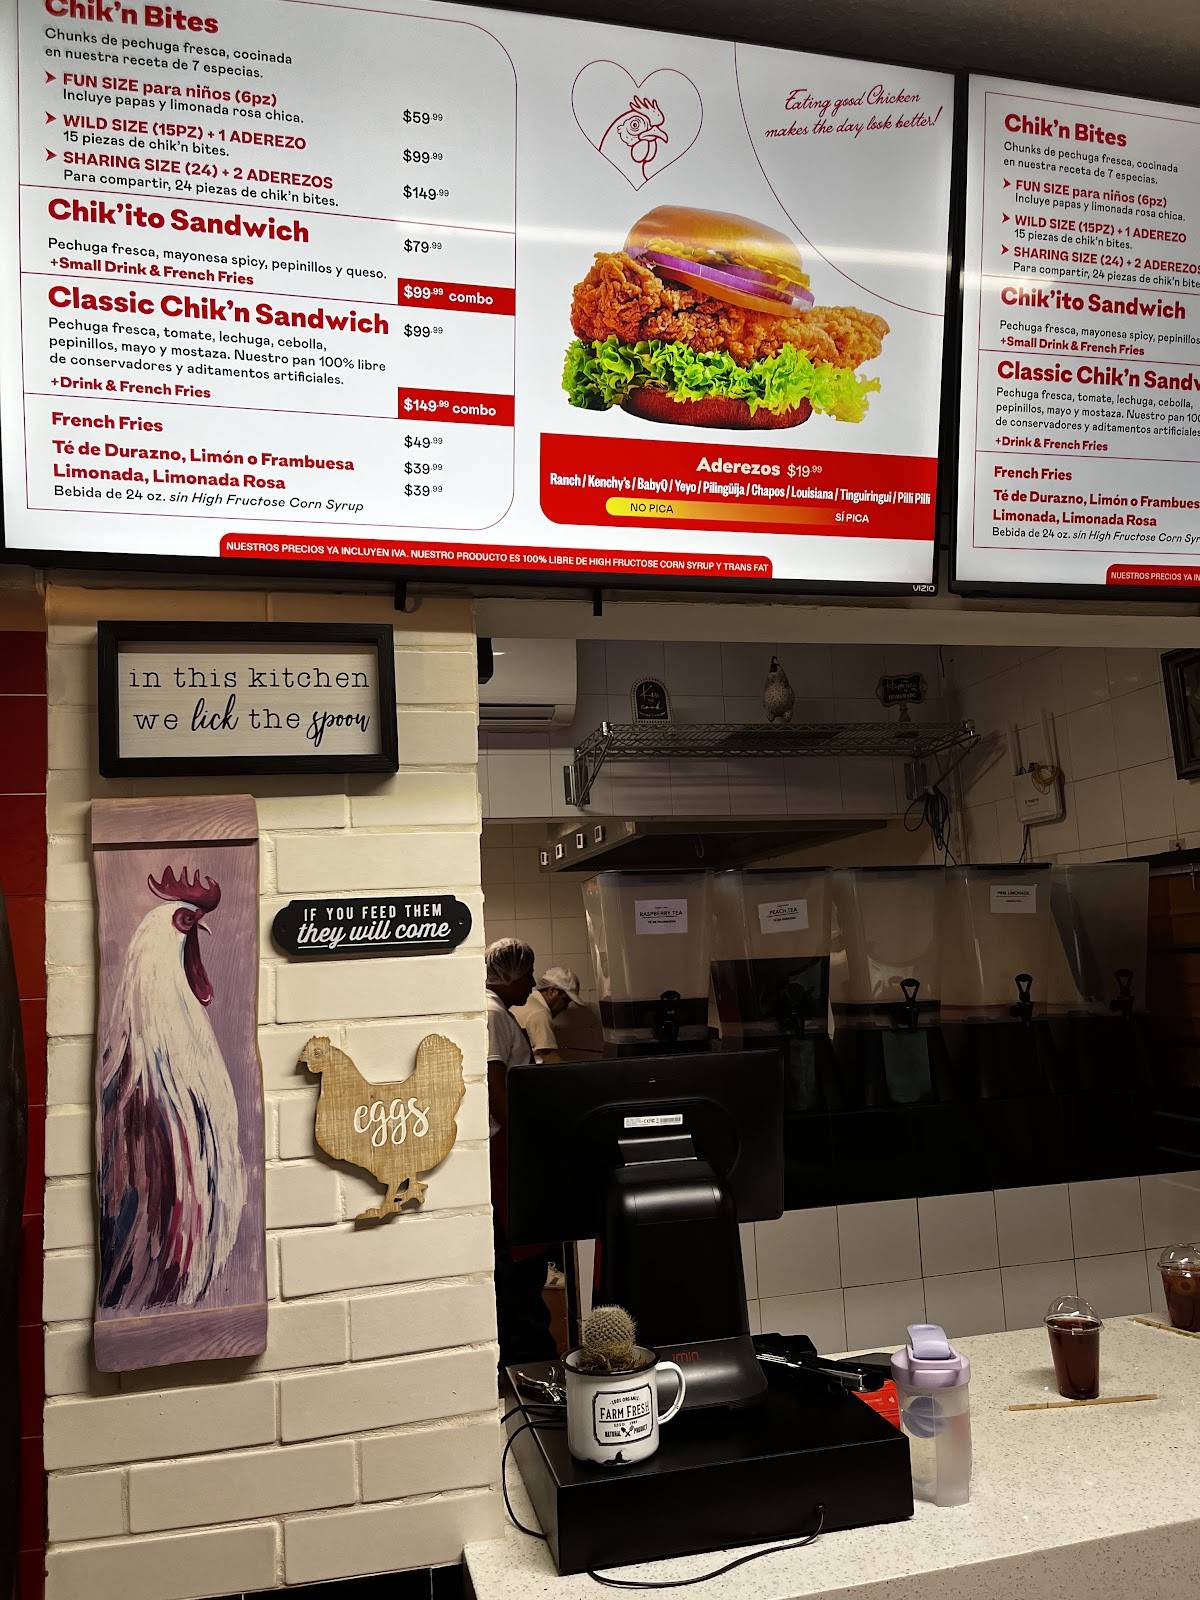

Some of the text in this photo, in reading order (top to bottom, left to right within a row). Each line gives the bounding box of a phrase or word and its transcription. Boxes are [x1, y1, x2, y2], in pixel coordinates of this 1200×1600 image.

[145, 5, 218, 33] Bites
[45, 27, 292, 64] Chunks de pechuga fresca, cocinada
[785, 84, 920, 118] Eating good Chicken
[402, 109, 443, 125] $59.99
[764, 105, 943, 139] makes the day look better!
[1004, 114, 1127, 147] Chik'n Bites
[402, 148, 443, 164] $99.99
[63, 151, 140, 170] SHARING
[144, 158, 181, 174] SIZE
[185, 161, 218, 179] (24)
[233, 167, 243, 180] 2
[247, 168, 333, 189] ADEREZOS
[64, 169, 338, 207] Para compartir, 24 piezas de chik'n bites.
[403, 184, 449, 200] $149.99
[1016, 180, 1167, 209] FUN SIZE para niños (6pz)
[48, 198, 309, 243] Chik'ito Sandwich
[403, 238, 442, 253] $79.99
[404, 284, 493, 305] $99.99 combo
[1001, 287, 1185, 319] Chik'ito Sandwich
[48, 286, 389, 335] Classic Chik'n Sandwich
[403, 323, 443, 338] $99.99
[404, 397, 496, 416] $149.99 combo
[52, 412, 163, 432] French Fries
[404, 435, 443, 449] $49.99
[995, 436, 1032, 447] +Drink
[1043, 438, 1080, 449] French
[1082, 440, 1108, 451] Fries
[52, 440, 354, 471] Té de Durazno, Limón o Frambuesa
[404, 461, 443, 475] $39.99
[696, 457, 822, 478] Aderezos $19.99
[994, 465, 1072, 481] French Fries
[54, 485, 364, 513] Bebida de 24 oz. sin High Fructose Corn Syrup
[404, 483, 443, 497] $39.99
[550, 472, 581, 486] Ranch
[588, 475, 631, 491] Kenchy's
[637, 477, 668, 493] BabyQ
[674, 479, 696, 495] Yeyo
[751, 484, 785, 499] Chapos
[791, 486, 833, 500] Louisiana
[840, 488, 892, 505] Tinguiringui
[630, 503, 674, 514] NO PICA
[835, 511, 869, 523] SÍ PICA
[226, 542, 768, 572] NUESTROS PRECIOS YA INCLUYEN IVA. NUESTRO PRODUCTO ES 100% LIBRE DE HIGH FRUCTOSE CORN SYRUP Y TRANS FAT
[1111, 572, 1150, 580] NUESTROS
[1151, 572, 1182, 580] PRECIOS
[1183, 573, 1192, 581] YA
[129, 667, 370, 688] in this kitchen
[133, 693, 370, 747] we lick the spoon
[304, 903, 441, 921] IF YOU FEED THEM
[297, 919, 451, 949] they will come
[354, 1097, 430, 1147] eggs
[600, 1401, 650, 1420] FARM FRESH
